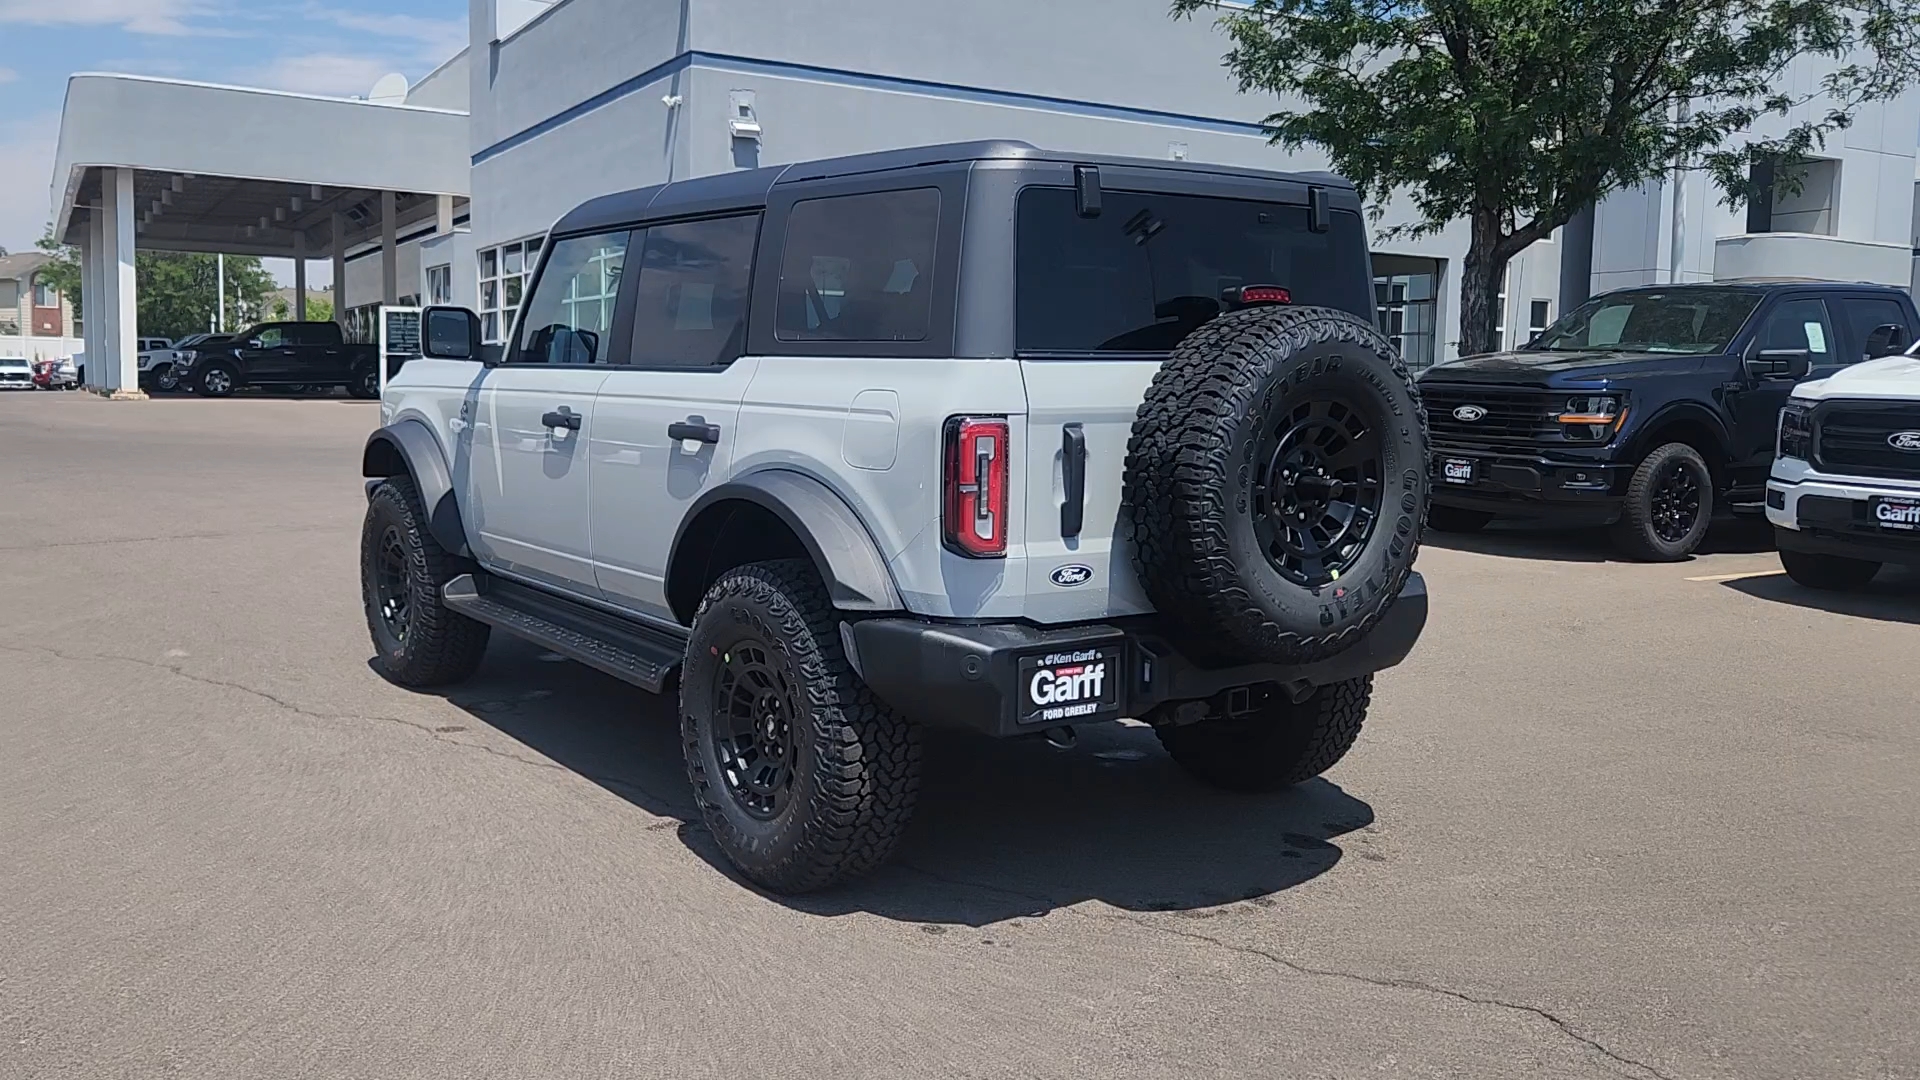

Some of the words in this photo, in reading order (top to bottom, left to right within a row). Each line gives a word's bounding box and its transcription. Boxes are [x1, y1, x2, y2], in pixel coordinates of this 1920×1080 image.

[1444, 463, 1472, 479] Garff
[1058, 568, 1087, 583] Ford
[1053, 653, 1072, 665] Ken
[1072, 649, 1096, 662] Garff
[1030, 662, 1105, 705] Garff
[1043, 708, 1063, 720] FORD
[1064, 703, 1098, 717] GREELEY
